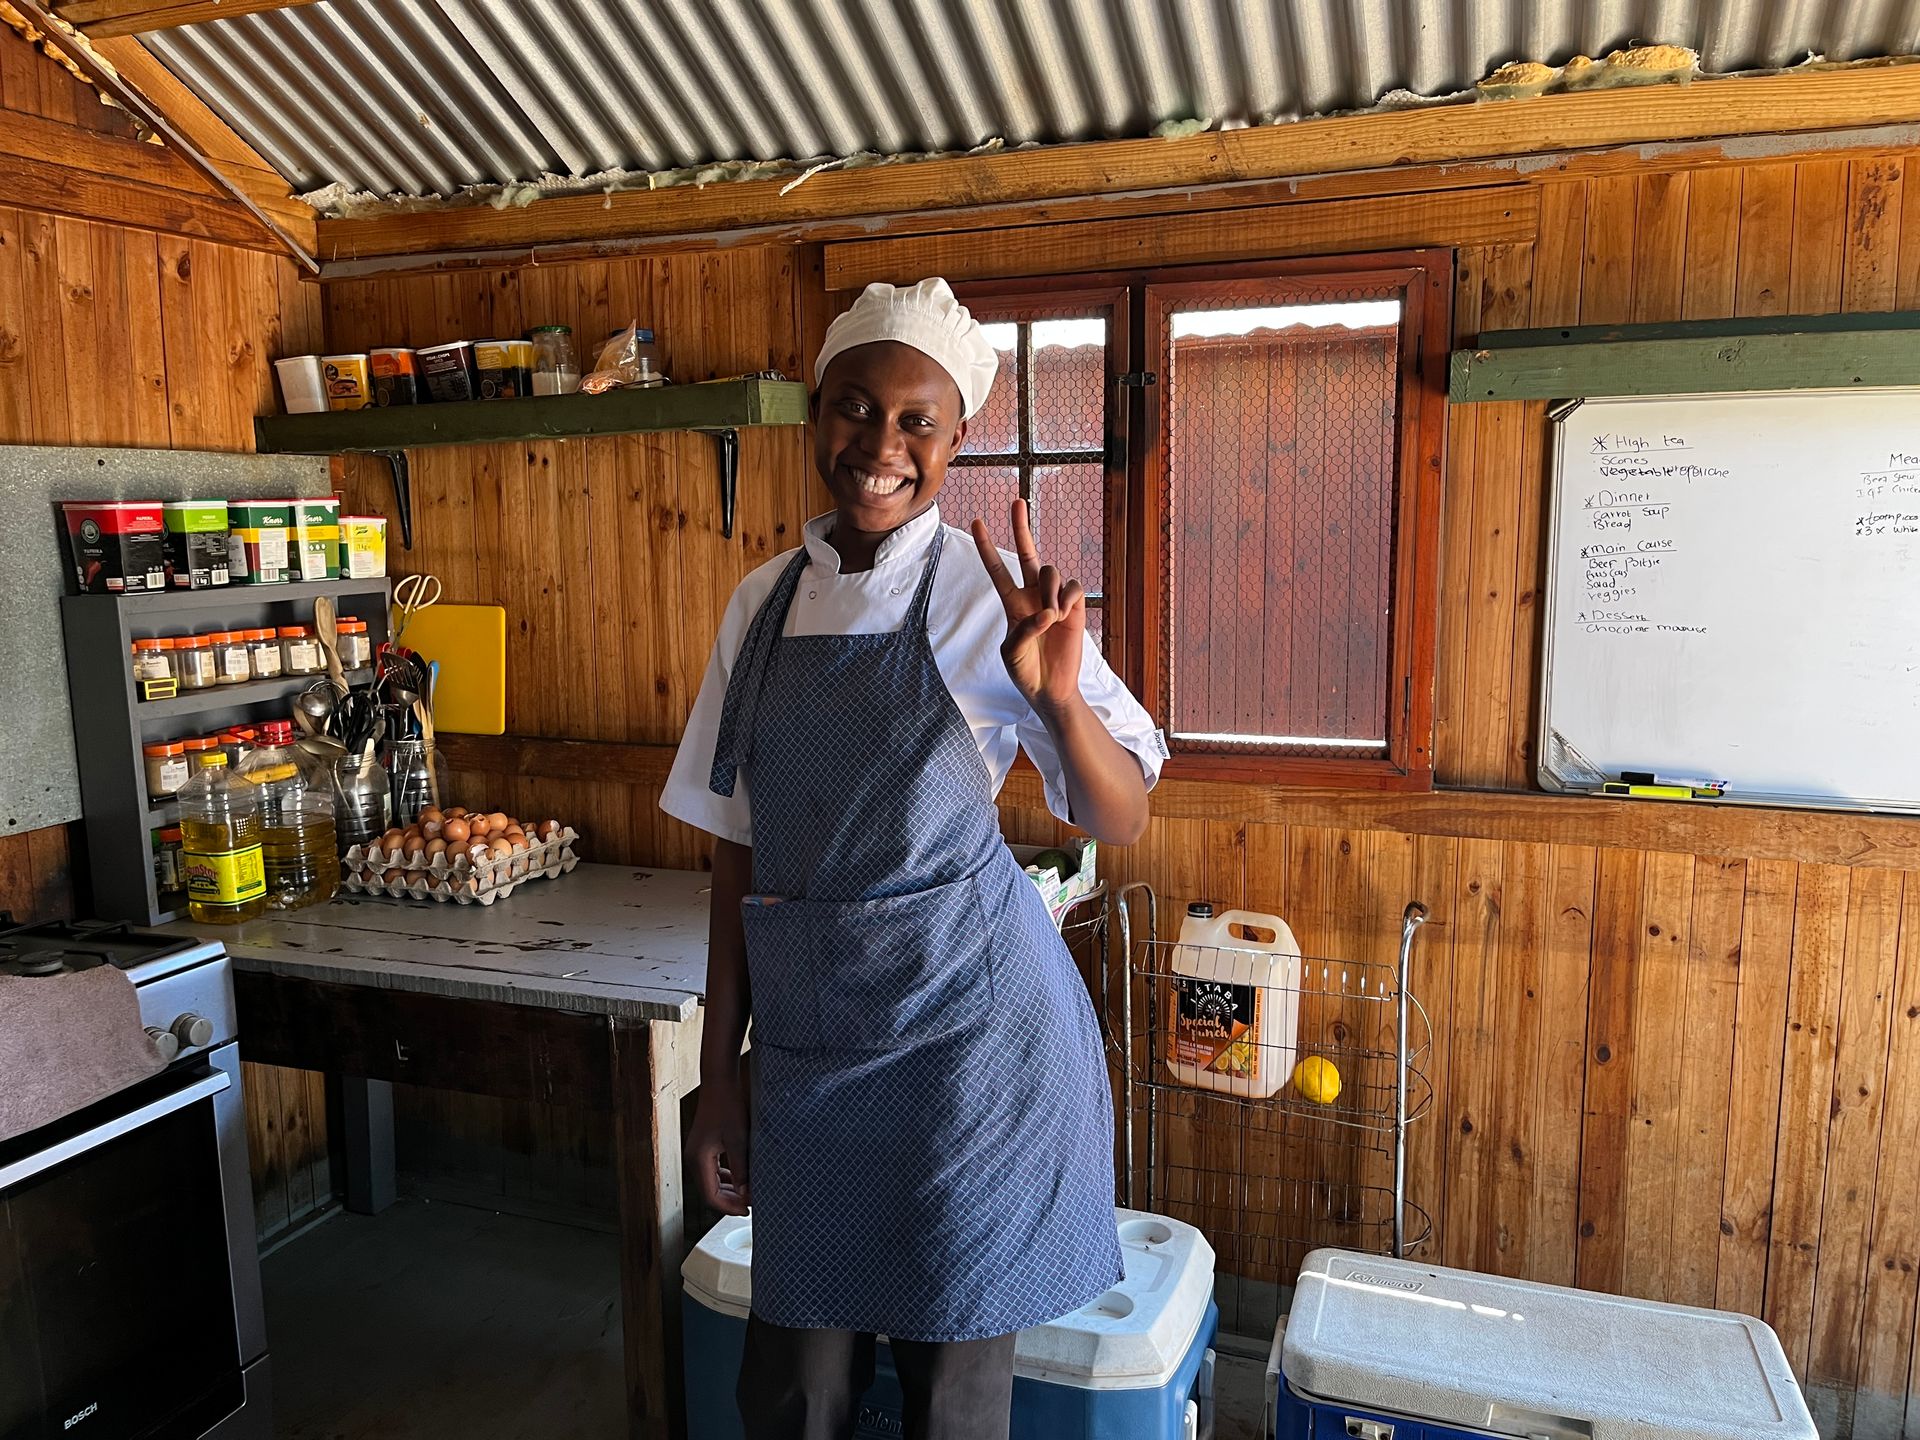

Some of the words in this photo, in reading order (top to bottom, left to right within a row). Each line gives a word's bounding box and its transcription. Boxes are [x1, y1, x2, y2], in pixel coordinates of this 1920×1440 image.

[1616, 434, 1649, 453] High
[1663, 434, 1685, 446] tea
[1889, 453, 1920, 468] Mea
[262, 515, 283, 525] Knorr
[1180, 1013, 1222, 1029] Special
[64, 1402, 97, 1429] BOSCH
[858, 1407, 902, 1433] Colem
